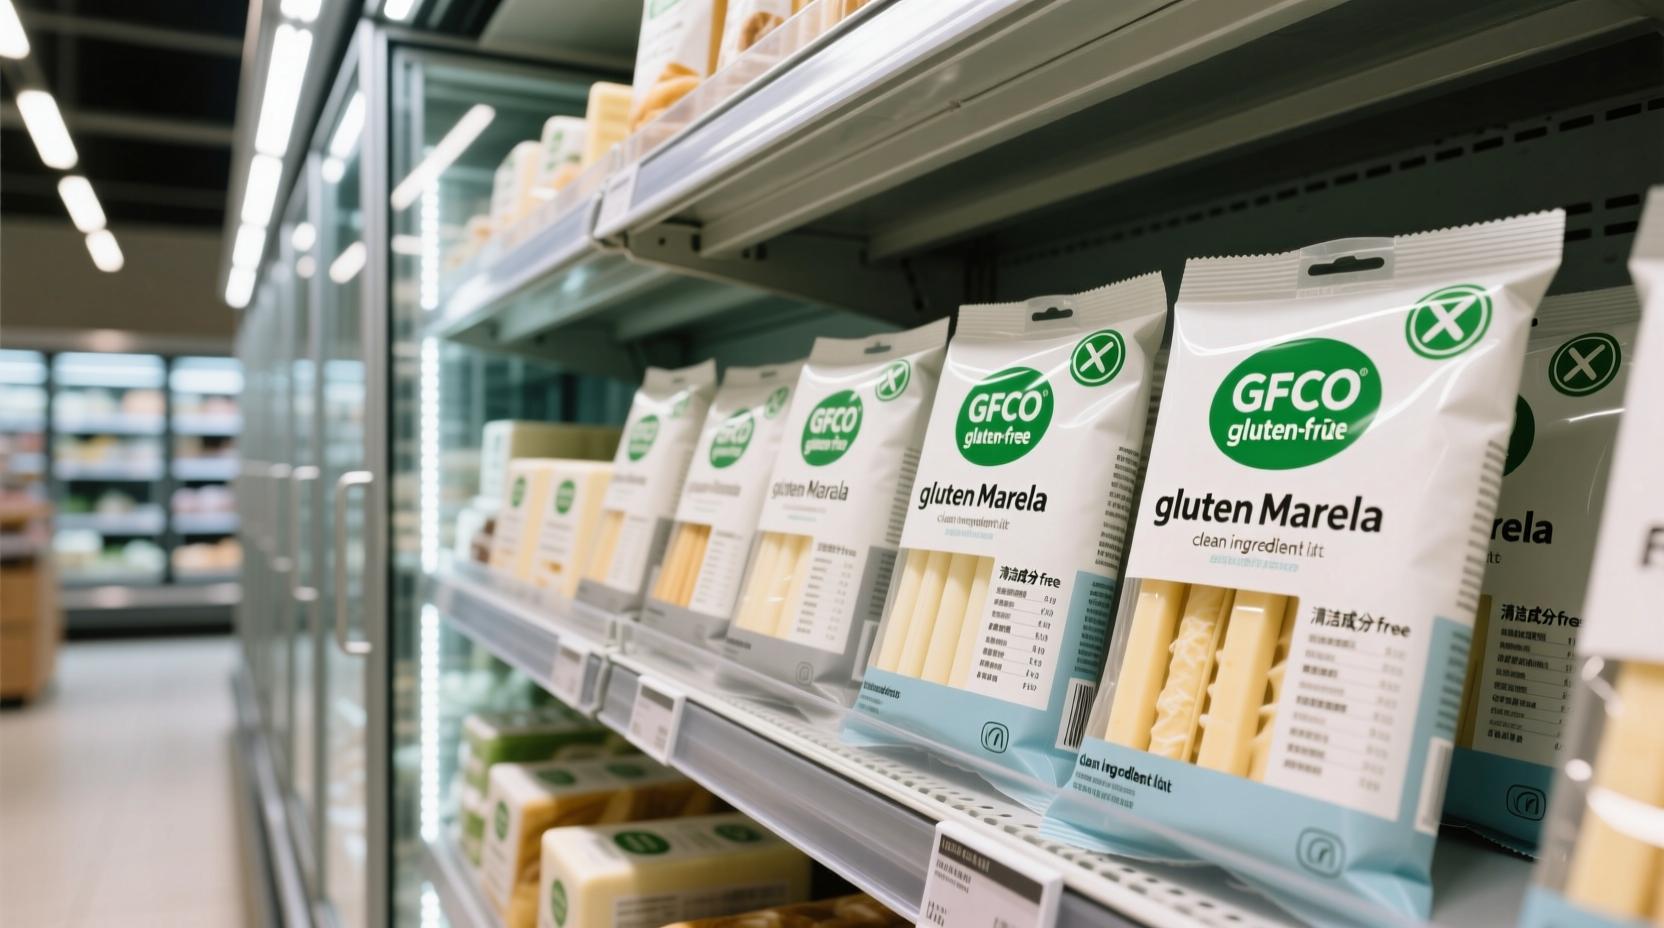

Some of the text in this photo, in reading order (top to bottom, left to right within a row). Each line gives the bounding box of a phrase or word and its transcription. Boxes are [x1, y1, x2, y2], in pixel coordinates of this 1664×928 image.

[968, 390, 1043, 424] GFCO
[1232, 368, 1362, 414] GFCO
[918, 481, 1048, 513] gluten Marela
[1153, 488, 1384, 534] gluten Marela
[1192, 532, 1227, 550] clean
[1377, 616, 1412, 638] free
